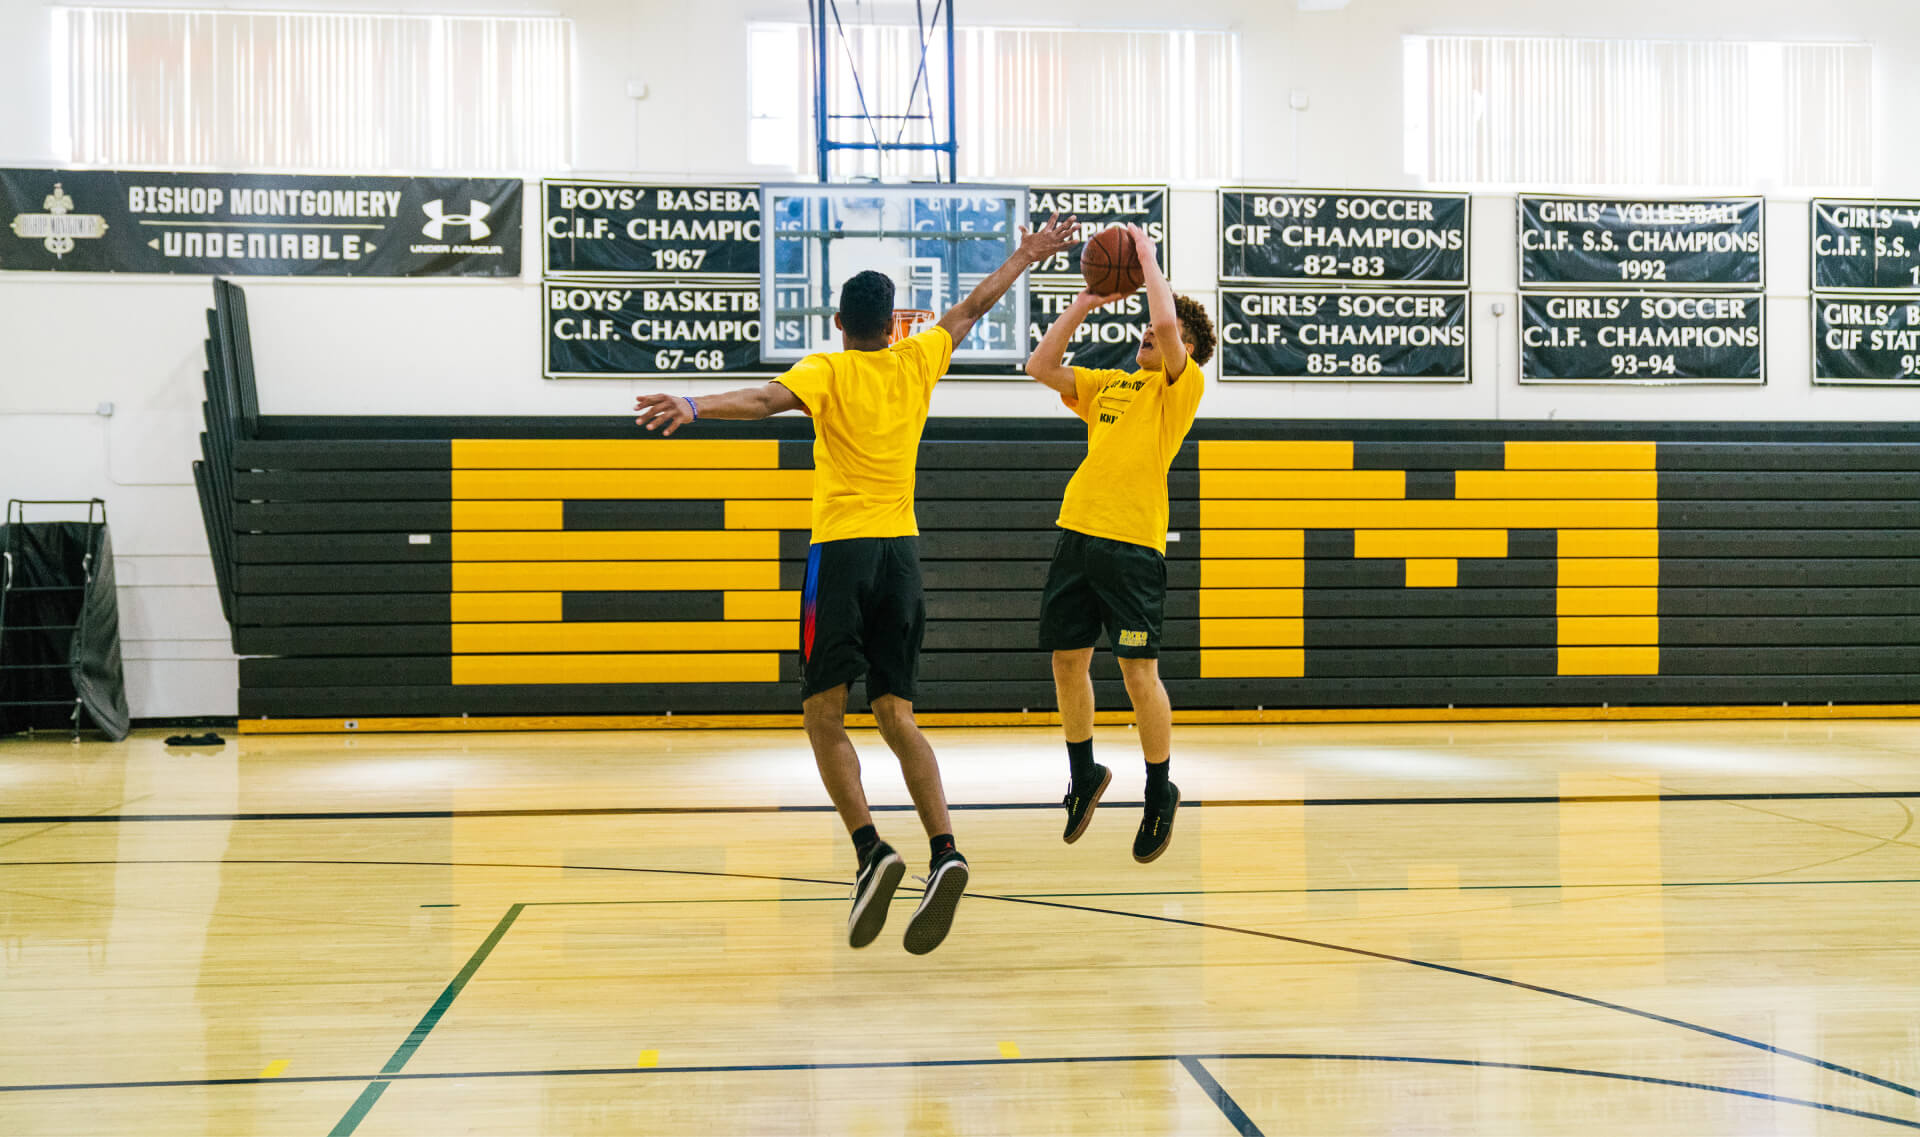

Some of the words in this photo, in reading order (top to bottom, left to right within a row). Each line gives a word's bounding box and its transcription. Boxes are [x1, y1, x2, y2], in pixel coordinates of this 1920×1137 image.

[129, 186, 223, 214] BISHOP
[230, 188, 402, 217] MONTGOMERY
[560, 187, 645, 210] BOYS'
[1253, 197, 1326, 218] BOYS'
[1336, 199, 1434, 221] SOCCER
[1539, 202, 1607, 223] GIRLS'
[1615, 203, 1742, 225] VOLLEYBALL
[1832, 207, 1899, 229] GIRLS'
[547, 216, 615, 240] C.I.F.
[1224, 223, 1271, 246] CIF
[1282, 225, 1463, 250] CHAMPIONS
[163, 231, 361, 260] UNDENIABLE
[410, 245, 450, 253] UNDER
[452, 245, 503, 254] ARMOUR
[1522, 230, 1574, 252] C.I.F.
[1582, 230, 1619, 252] S.S.
[1628, 231, 1760, 253] CHAMPIONS
[1816, 234, 1867, 257] C.I.F.
[1875, 235, 1910, 257] S.S.
[651, 249, 706, 270] 1967
[1303, 255, 1385, 276] 82-83
[1617, 260, 1666, 281] 1992
[550, 289, 633, 310] BOYS'
[1037, 294, 1143, 314] TENIS
[1241, 294, 1326, 316] GIRLS'
[1338, 296, 1446, 318] SOCCER
[1546, 298, 1628, 319] GIRLS'
[1641, 298, 1746, 319] SOCCER
[1824, 304, 1896, 325] GIRLS'
[554, 319, 620, 341] C.I.F.
[1222, 323, 1287, 345] C.I.F.
[1298, 324, 1465, 347] CHAMPIONS
[1523, 326, 1587, 348] C.I.F.
[1598, 326, 1759, 348] CHAMPIONS
[1826, 329, 1863, 350] CIF
[1870, 330, 1920, 351] STAT
[655, 350, 724, 370] 67-68
[1307, 353, 1382, 374] 85-86
[1611, 354, 1676, 375] 93-94
[1199, 440, 1659, 678] M
